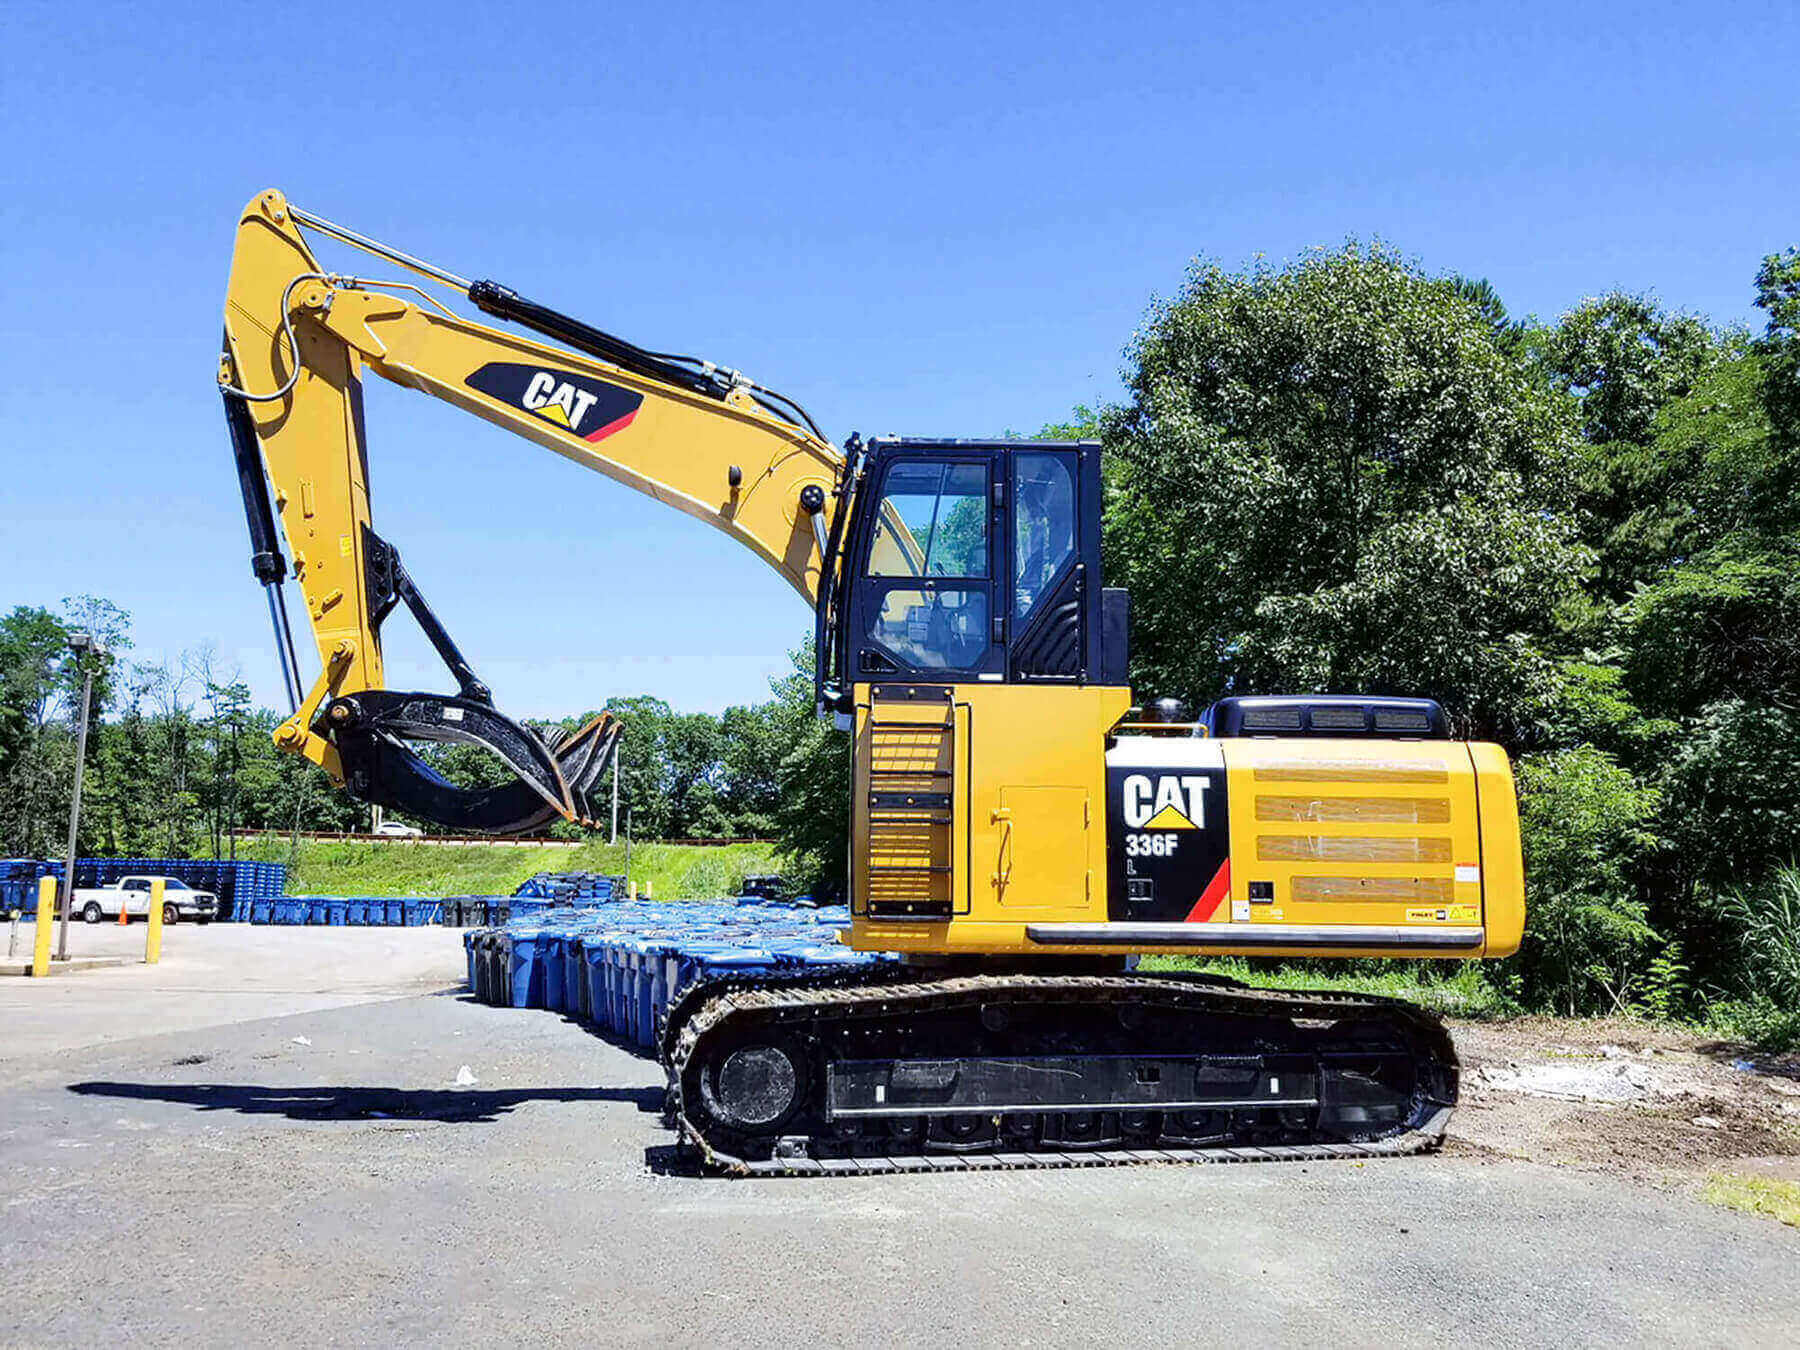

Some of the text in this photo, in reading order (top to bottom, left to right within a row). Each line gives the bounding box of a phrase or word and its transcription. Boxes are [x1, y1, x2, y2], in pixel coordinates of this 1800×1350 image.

[522, 372, 599, 431] CAT
[1123, 774, 1210, 829] CAT
[1126, 834, 1178, 856] 336F
